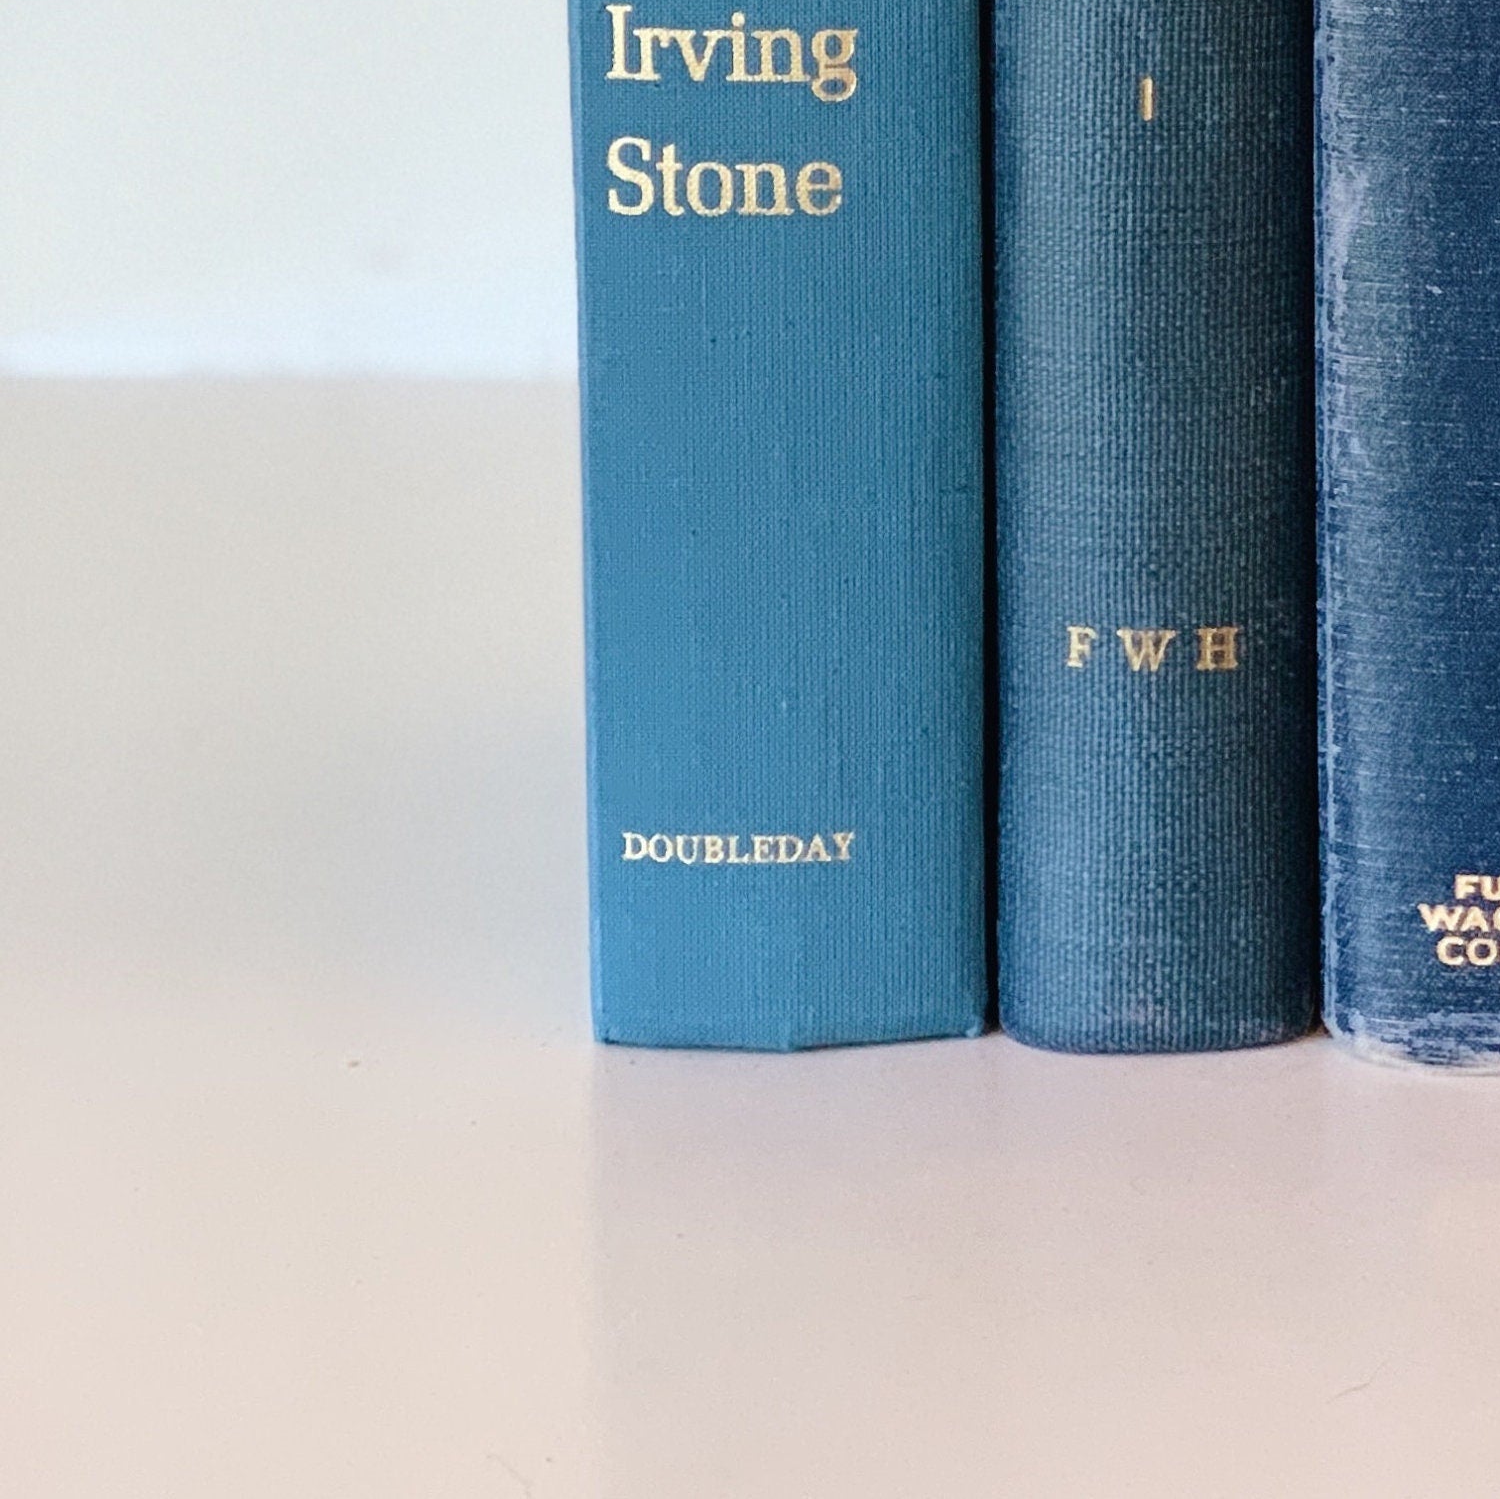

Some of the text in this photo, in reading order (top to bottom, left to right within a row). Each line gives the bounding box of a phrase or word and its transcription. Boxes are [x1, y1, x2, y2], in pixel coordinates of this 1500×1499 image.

[604, 3, 860, 103] Irving
[606, 136, 844, 218] Stone
[622, 830, 858, 866] DOUBLEDAY
